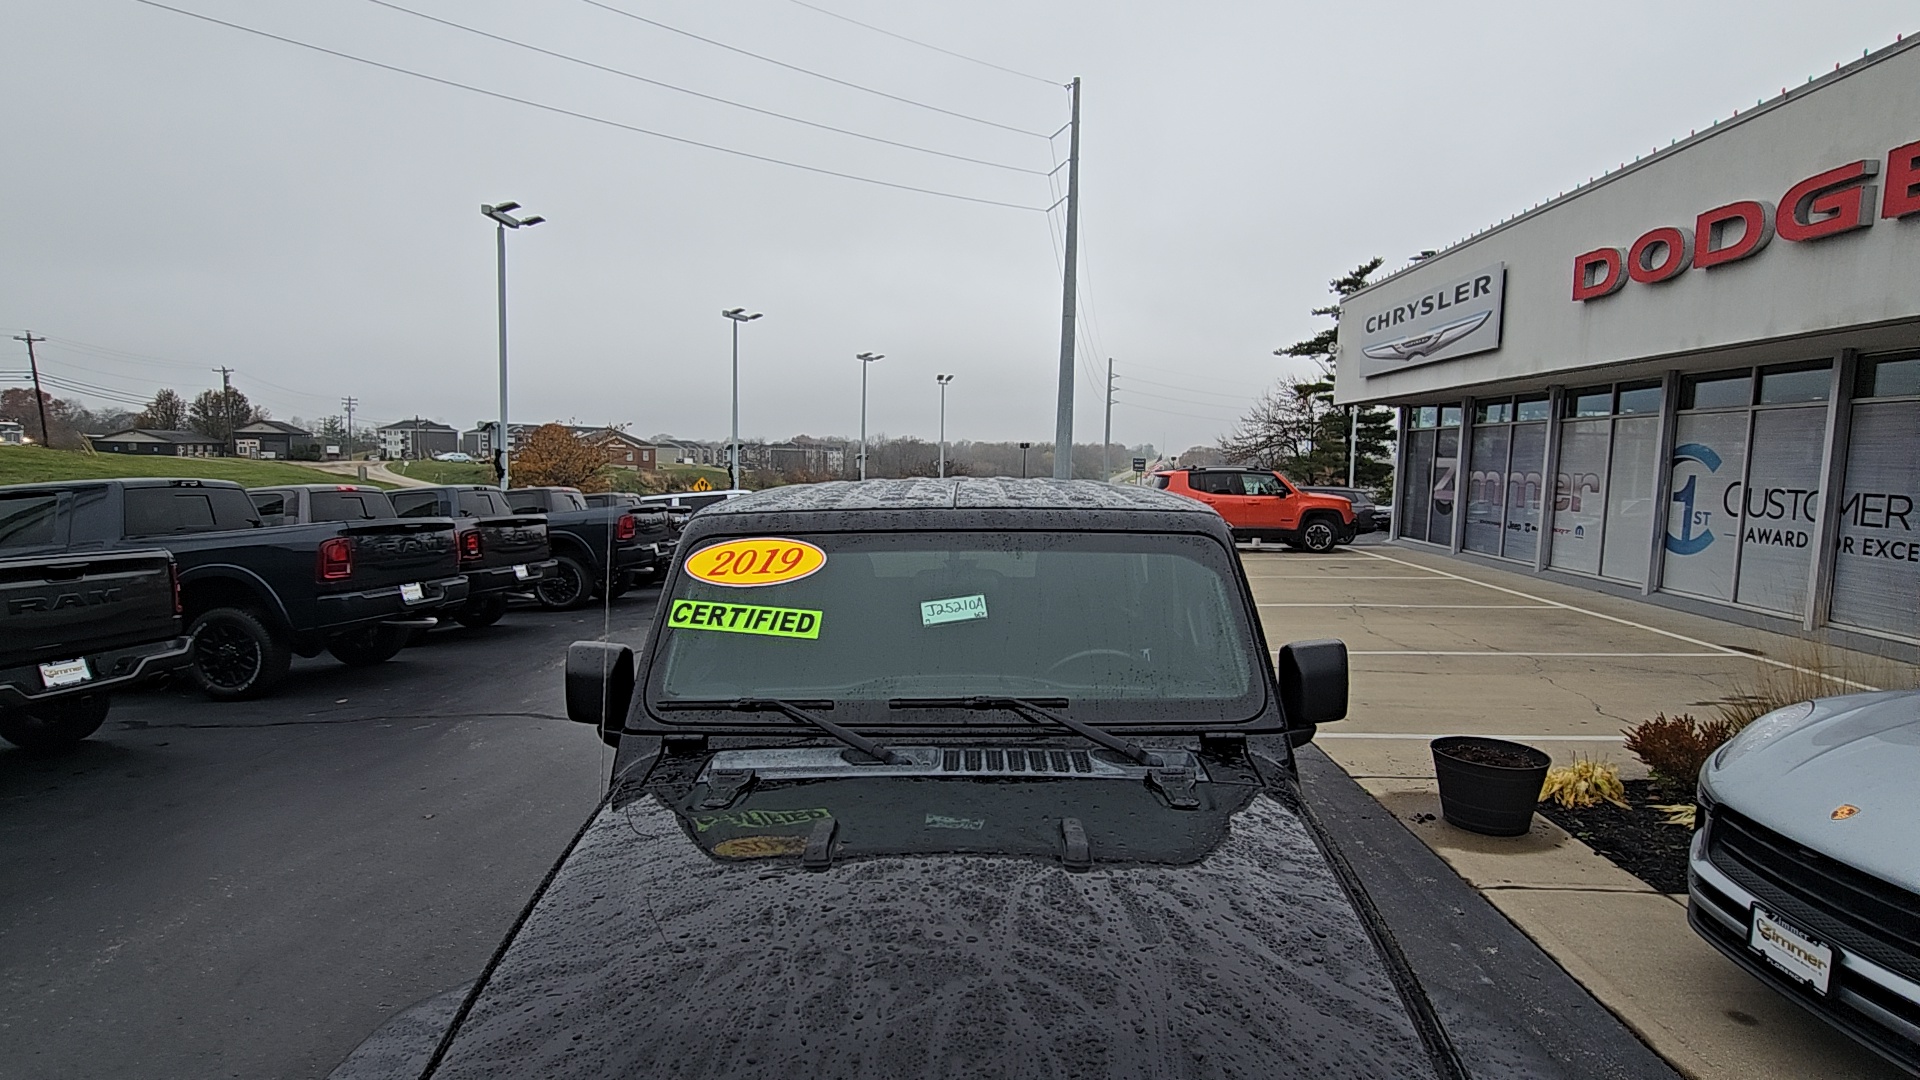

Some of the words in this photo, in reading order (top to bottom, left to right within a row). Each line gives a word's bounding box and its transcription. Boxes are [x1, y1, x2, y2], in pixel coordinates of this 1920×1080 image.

[1365, 274, 1492, 334] CHRYSLER
[1433, 456, 1600, 513] Zmmer
[1745, 527, 1809, 549] AWARD
[707, 546, 804, 576] 2019
[8, 587, 122, 616] RAM
[672, 602, 816, 634] CERTIFIED
[1757, 918, 1828, 970] Zimmer
